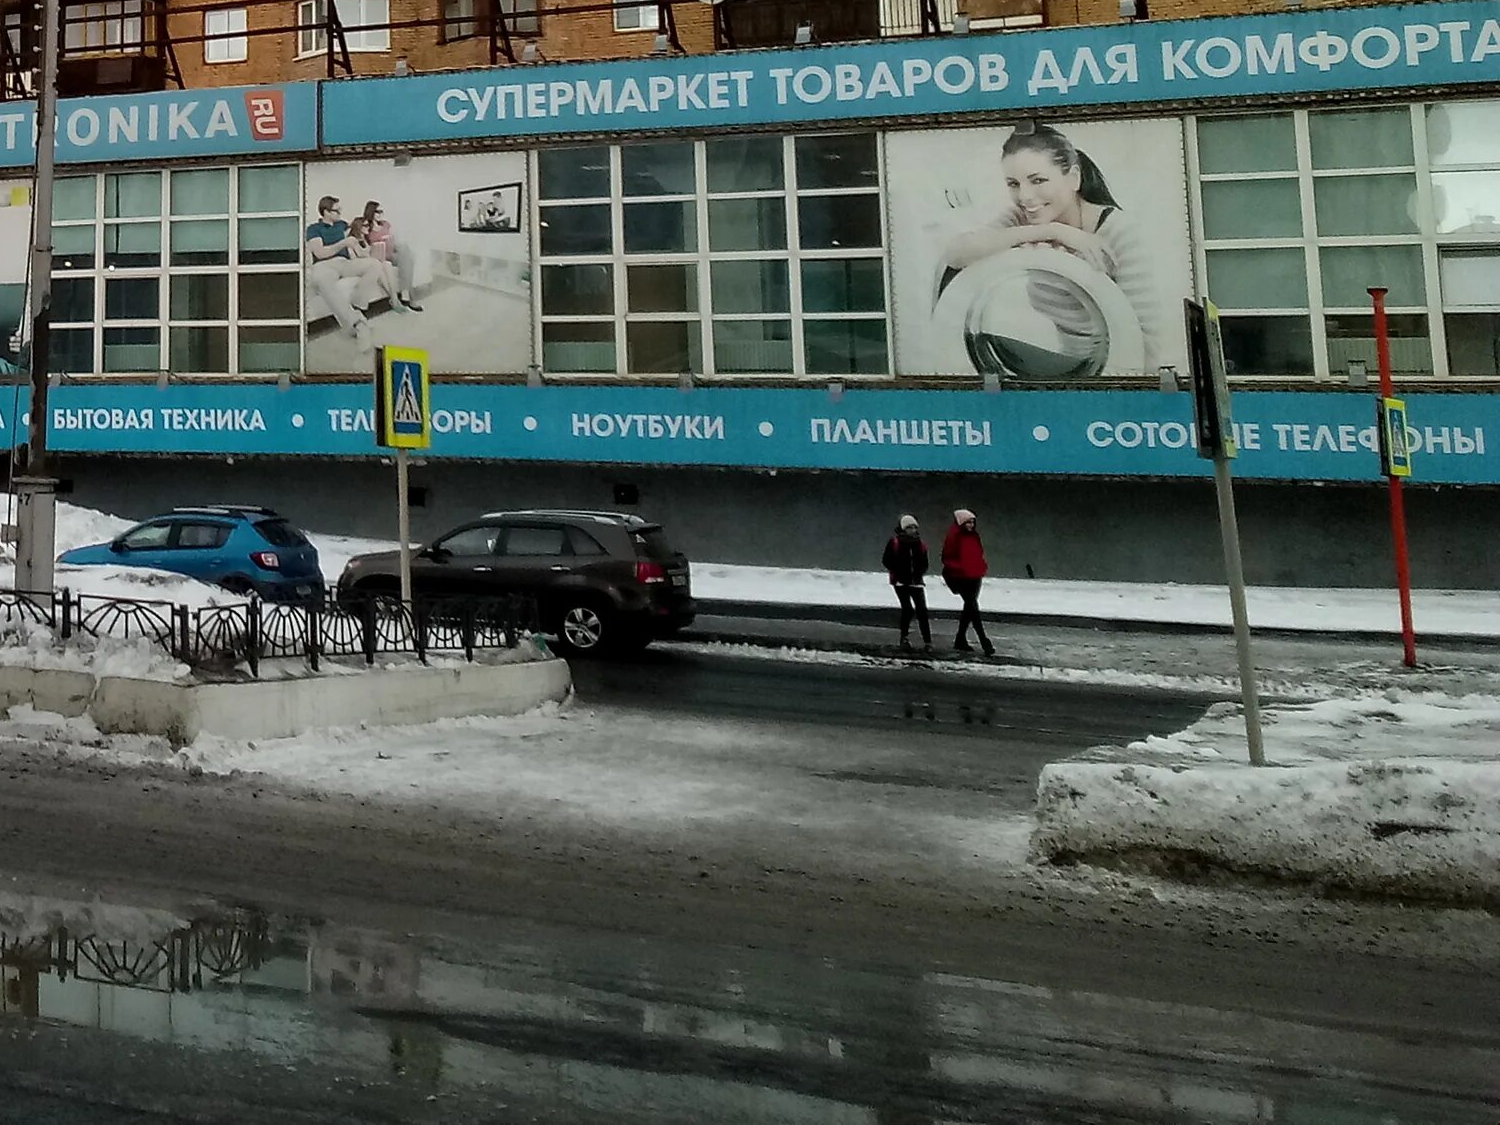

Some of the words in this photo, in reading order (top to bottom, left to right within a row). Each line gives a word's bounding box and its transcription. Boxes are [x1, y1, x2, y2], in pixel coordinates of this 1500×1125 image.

[437, 70, 754, 123] СУПЕРМАРКЕТ
[769, 53, 1009, 106] ТОВАРОВ
[1027, 43, 1138, 96] ДЛЯ
[1162, 19, 1500, 81] КОМФОРТА
[251, 98, 279, 135] RU
[53, 407, 154, 431] БЫТОВАЯ
[160, 408, 266, 432] ТЕХНИКА
[327, 409, 492, 434] ТЕЛОРЫ
[571, 413, 725, 440] НОУТБУКИ
[810, 418, 992, 447] ПЛАНШЕТЫ
[1087, 421, 1261, 450] СОТОЕ
